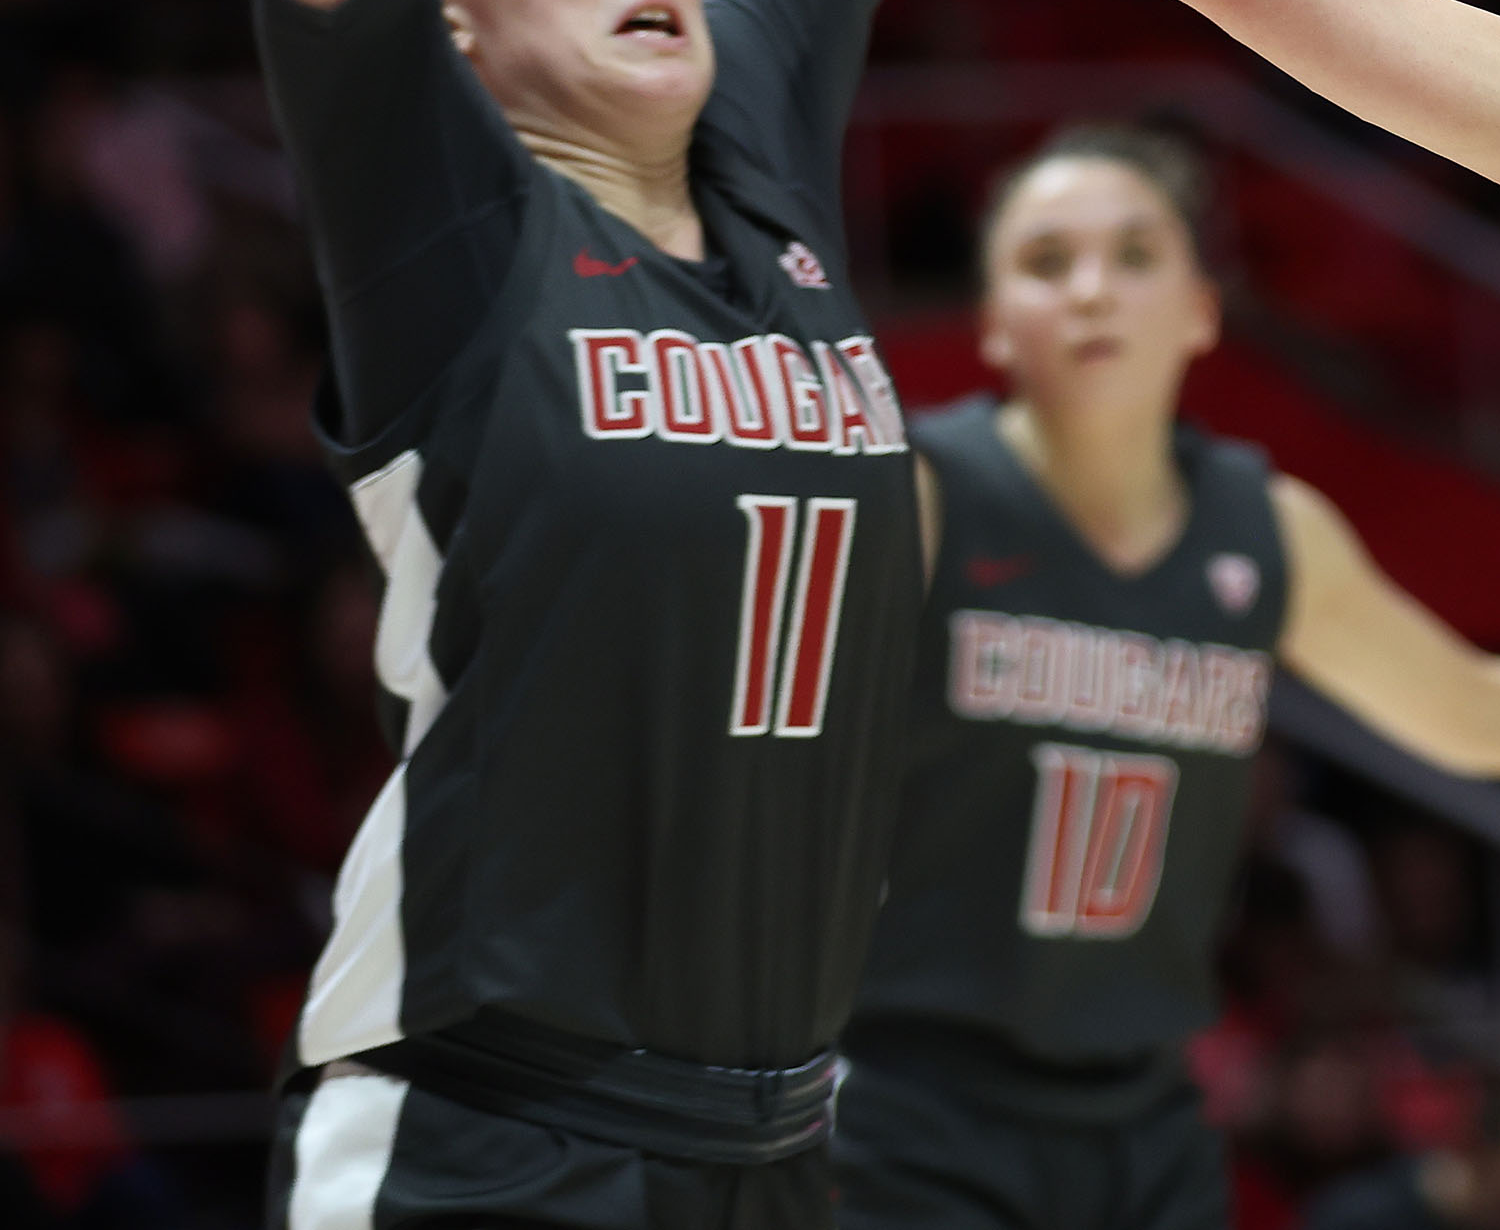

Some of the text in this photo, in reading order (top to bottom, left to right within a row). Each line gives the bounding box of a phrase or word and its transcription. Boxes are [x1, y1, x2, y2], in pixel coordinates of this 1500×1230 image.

[568, 329, 909, 455] COUGA
[729, 493, 857, 736] 11
[948, 609, 1271, 758] COUGARS
[1019, 741, 1180, 939] 10
